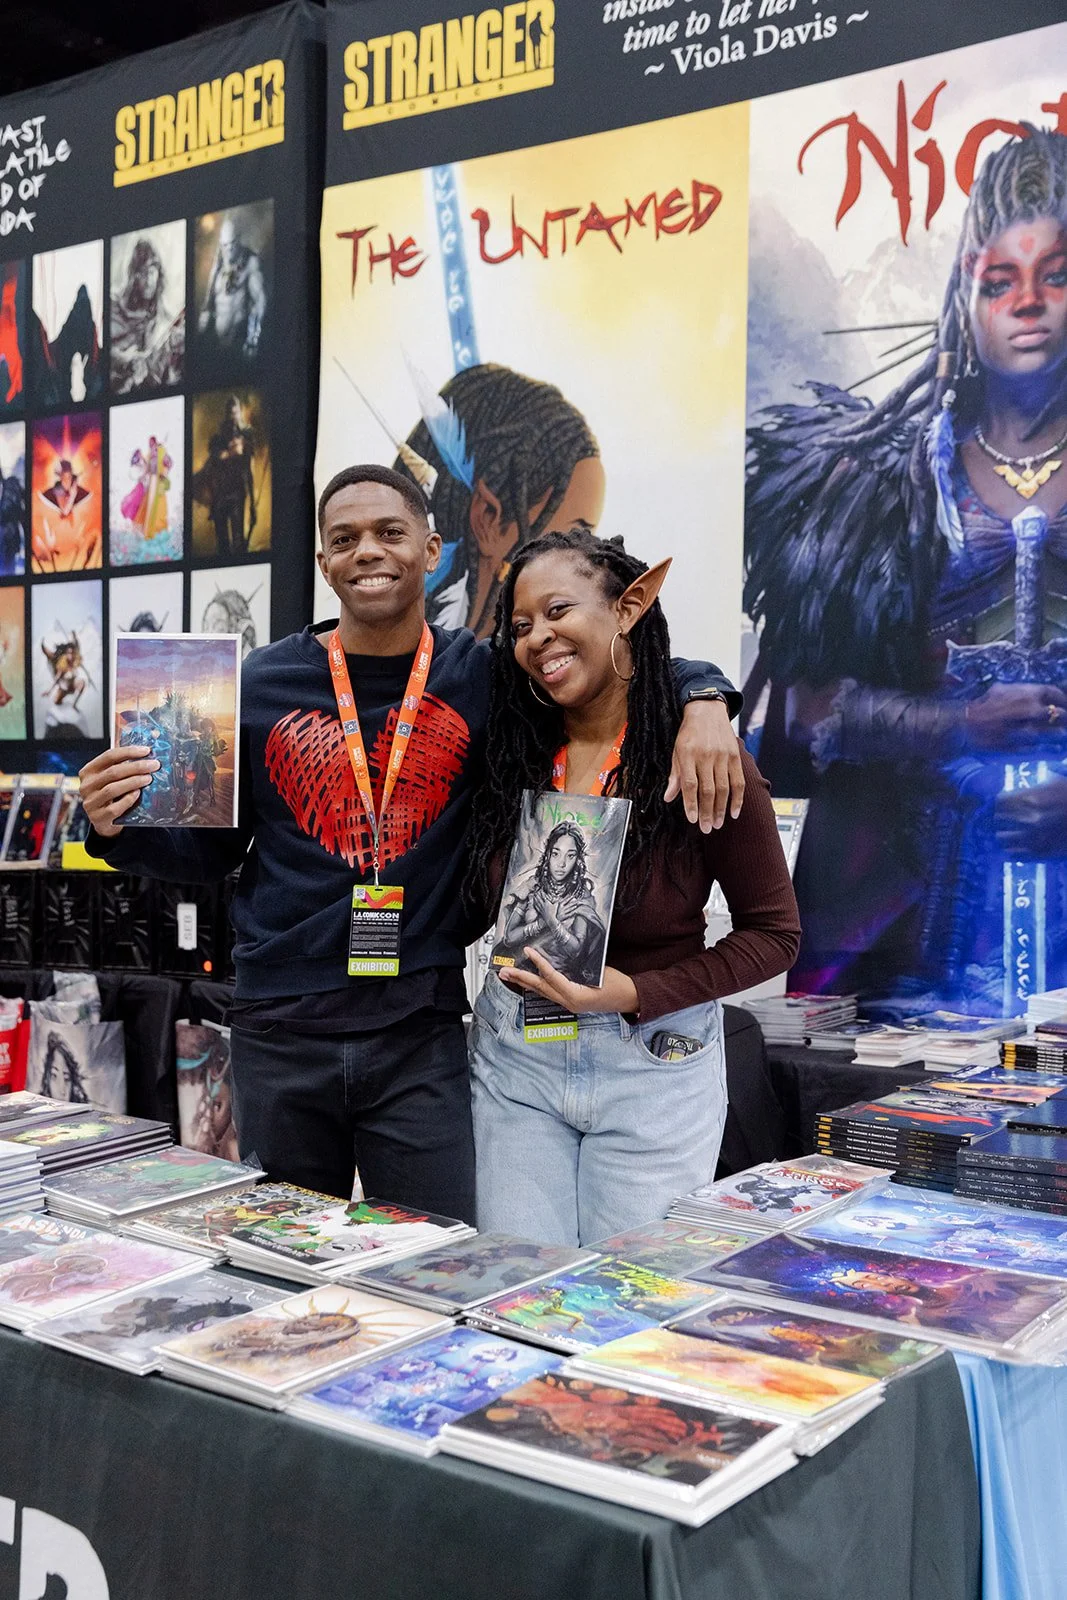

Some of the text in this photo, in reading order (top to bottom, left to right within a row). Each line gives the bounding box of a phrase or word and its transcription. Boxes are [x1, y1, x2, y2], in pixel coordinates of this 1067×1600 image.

[623, 20, 680, 53] time
[685, 10, 711, 38] to
[718, 0, 751, 29] let
[671, 33, 747, 75] Viola
[752, 11, 838, 57] Davis
[344, 0, 556, 111] STRANGER
[0, 115, 46, 149] AST
[114, 58, 285, 172] STRANGER
[18, 173, 47, 201] OF
[336, 224, 430, 300] THE
[470, 179, 723, 264] UNTAMED
[351, 961, 395, 972] EXHIBITOR
[527, 1026, 574, 1039] EXHIBITOR
